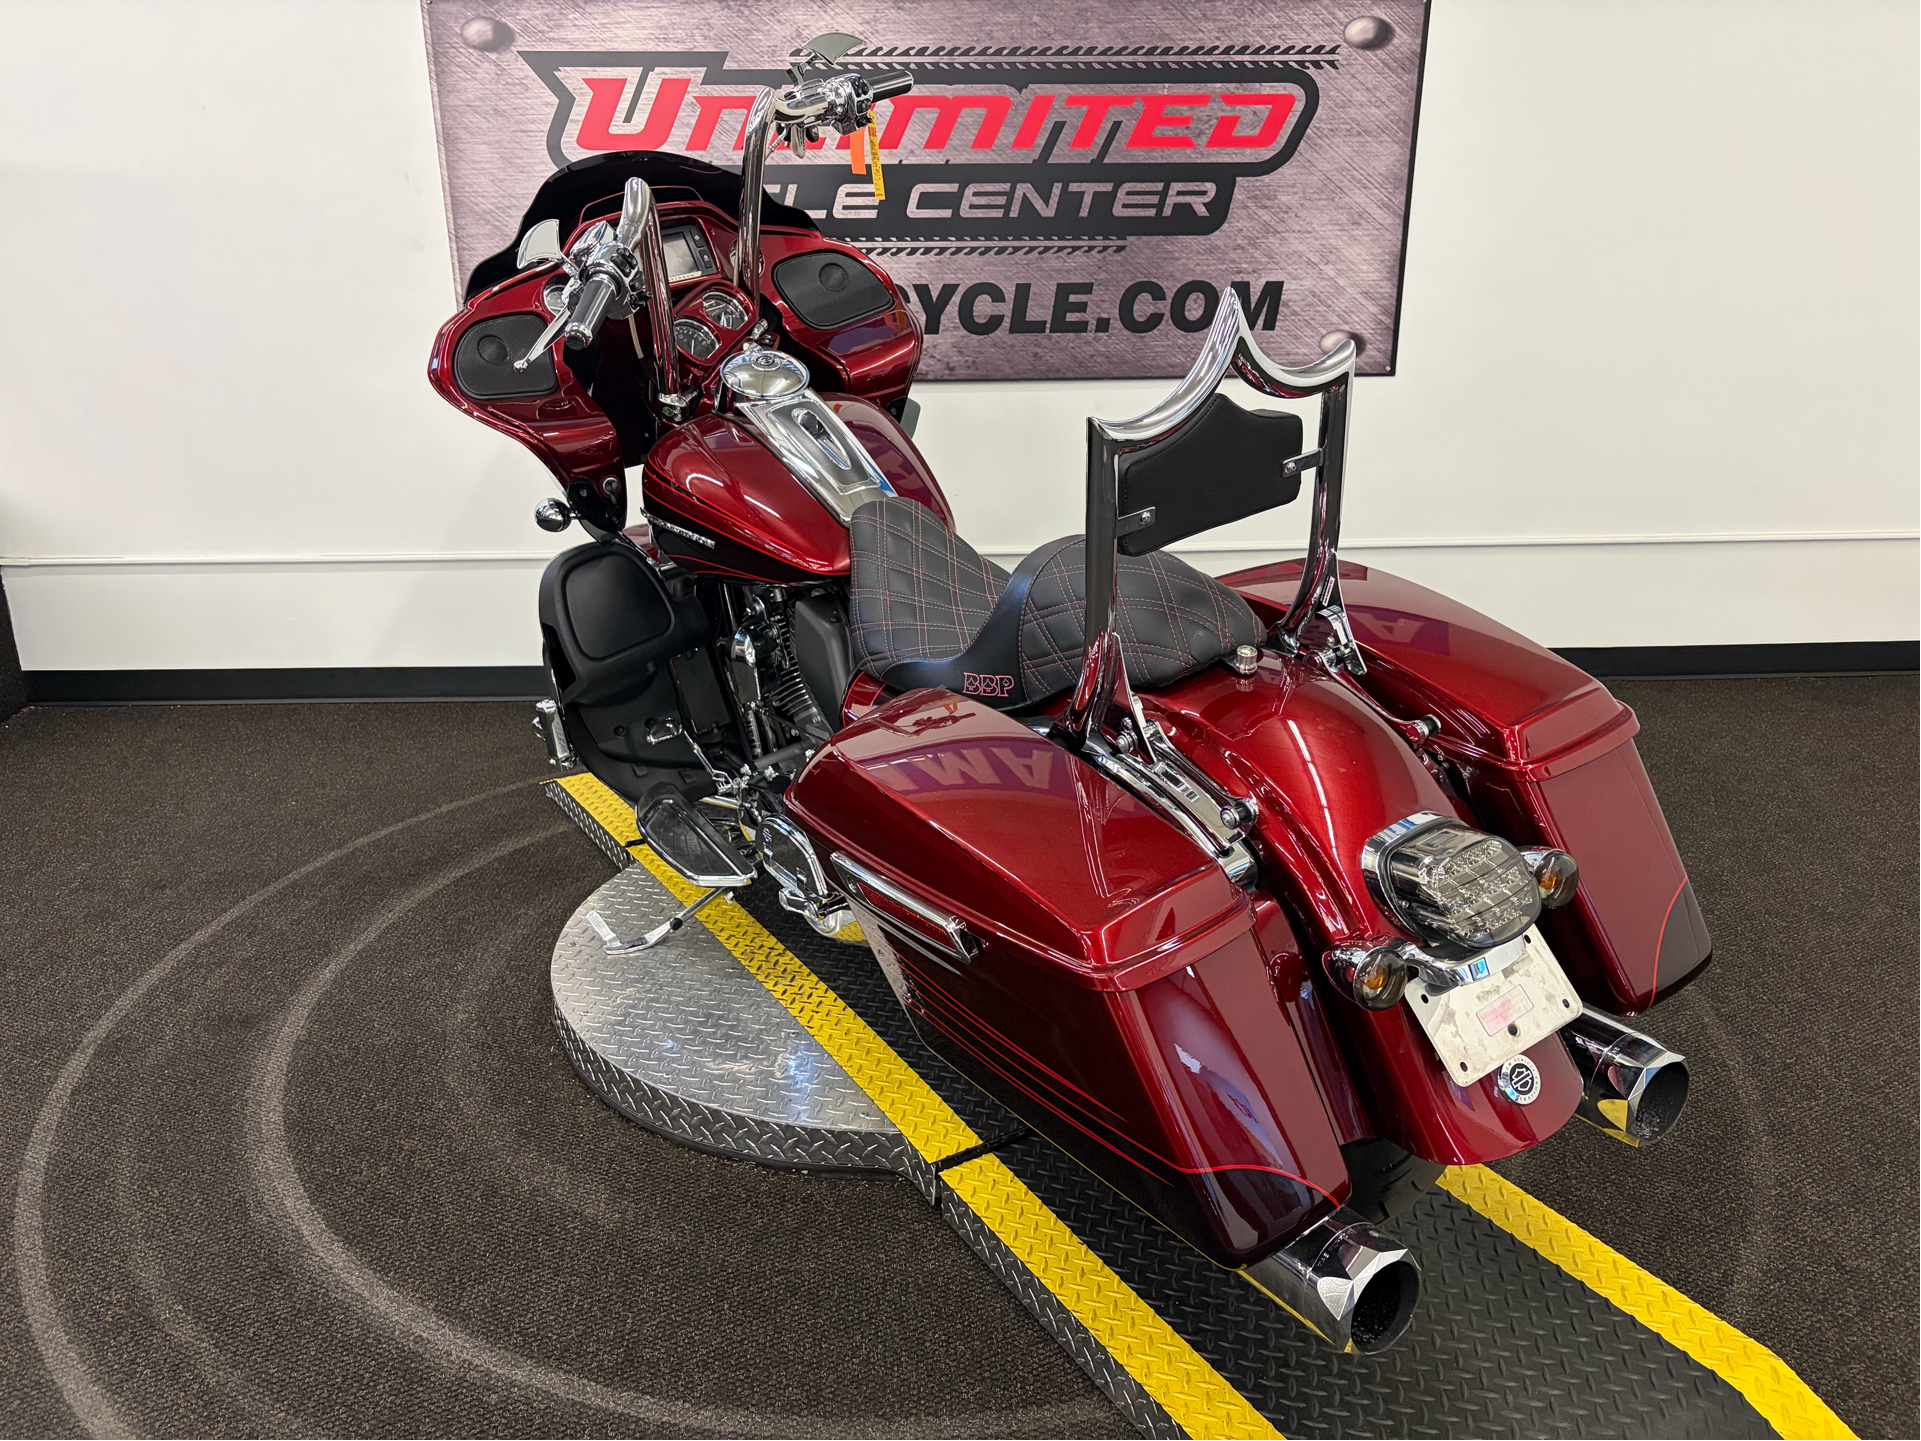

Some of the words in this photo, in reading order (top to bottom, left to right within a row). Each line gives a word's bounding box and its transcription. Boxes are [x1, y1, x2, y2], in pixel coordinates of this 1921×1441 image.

[576, 77, 1297, 151] UNMITED
[906, 181, 1217, 219] CENTER
[894, 280, 1285, 336] YCLE.COM
[963, 672, 1015, 697] BBP
